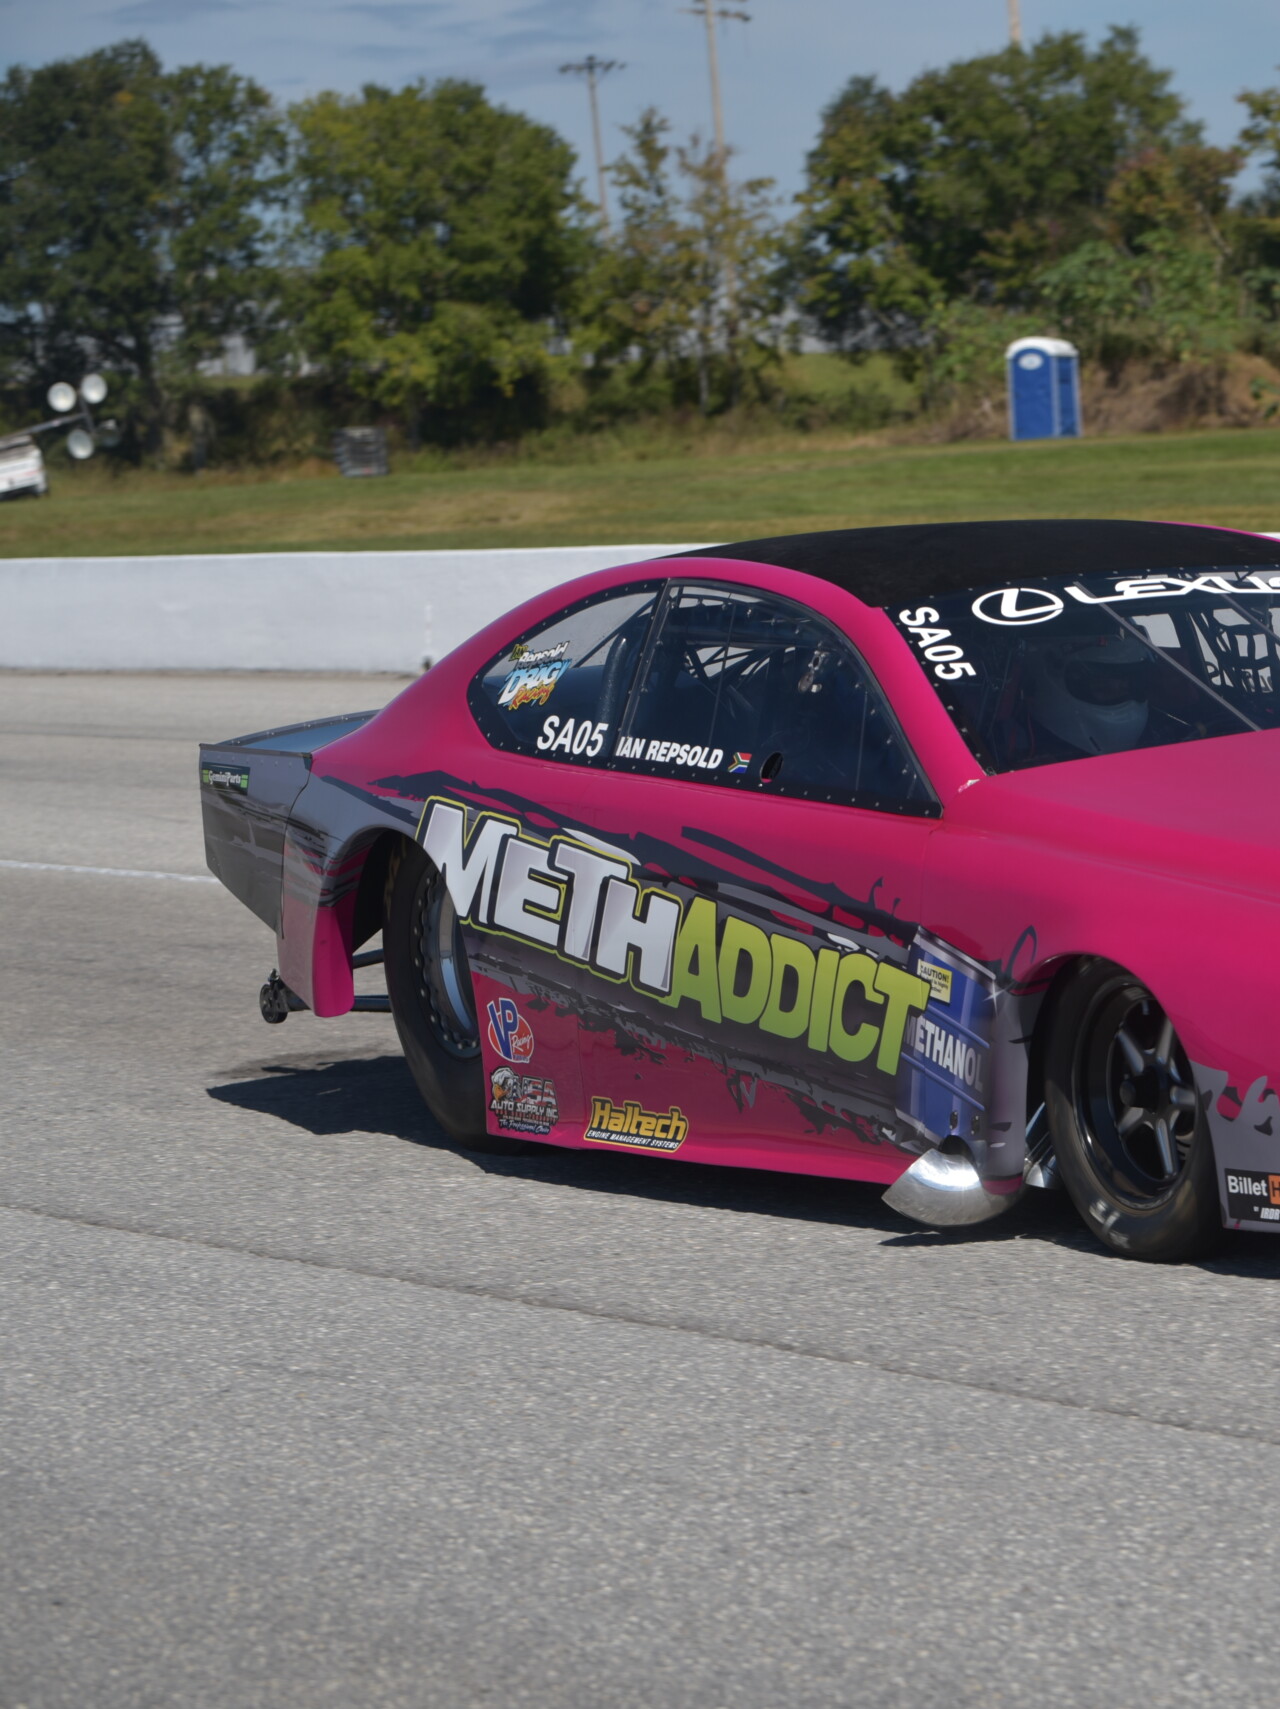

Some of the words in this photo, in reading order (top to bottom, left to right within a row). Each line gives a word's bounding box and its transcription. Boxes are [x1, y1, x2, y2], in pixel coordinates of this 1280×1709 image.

[899, 606, 976, 681] SA05
[498, 660, 565, 705] DRAG
[536, 715, 609, 757] SA05
[615, 736, 643, 759] IAN
[645, 740, 724, 769] REPSOLD
[487, 997, 519, 1061] VP
[903, 1013, 983, 1092] METHANOL
[490, 1100, 514, 1111] AUTO
[516, 1103, 545, 1116] SUPPLY
[591, 1101, 687, 1141] Haltech
[587, 1130, 611, 1140] ENGINE
[610, 1133, 652, 1145] MANAGEMENT
[650, 1139, 680, 1149] SYSTEMS
